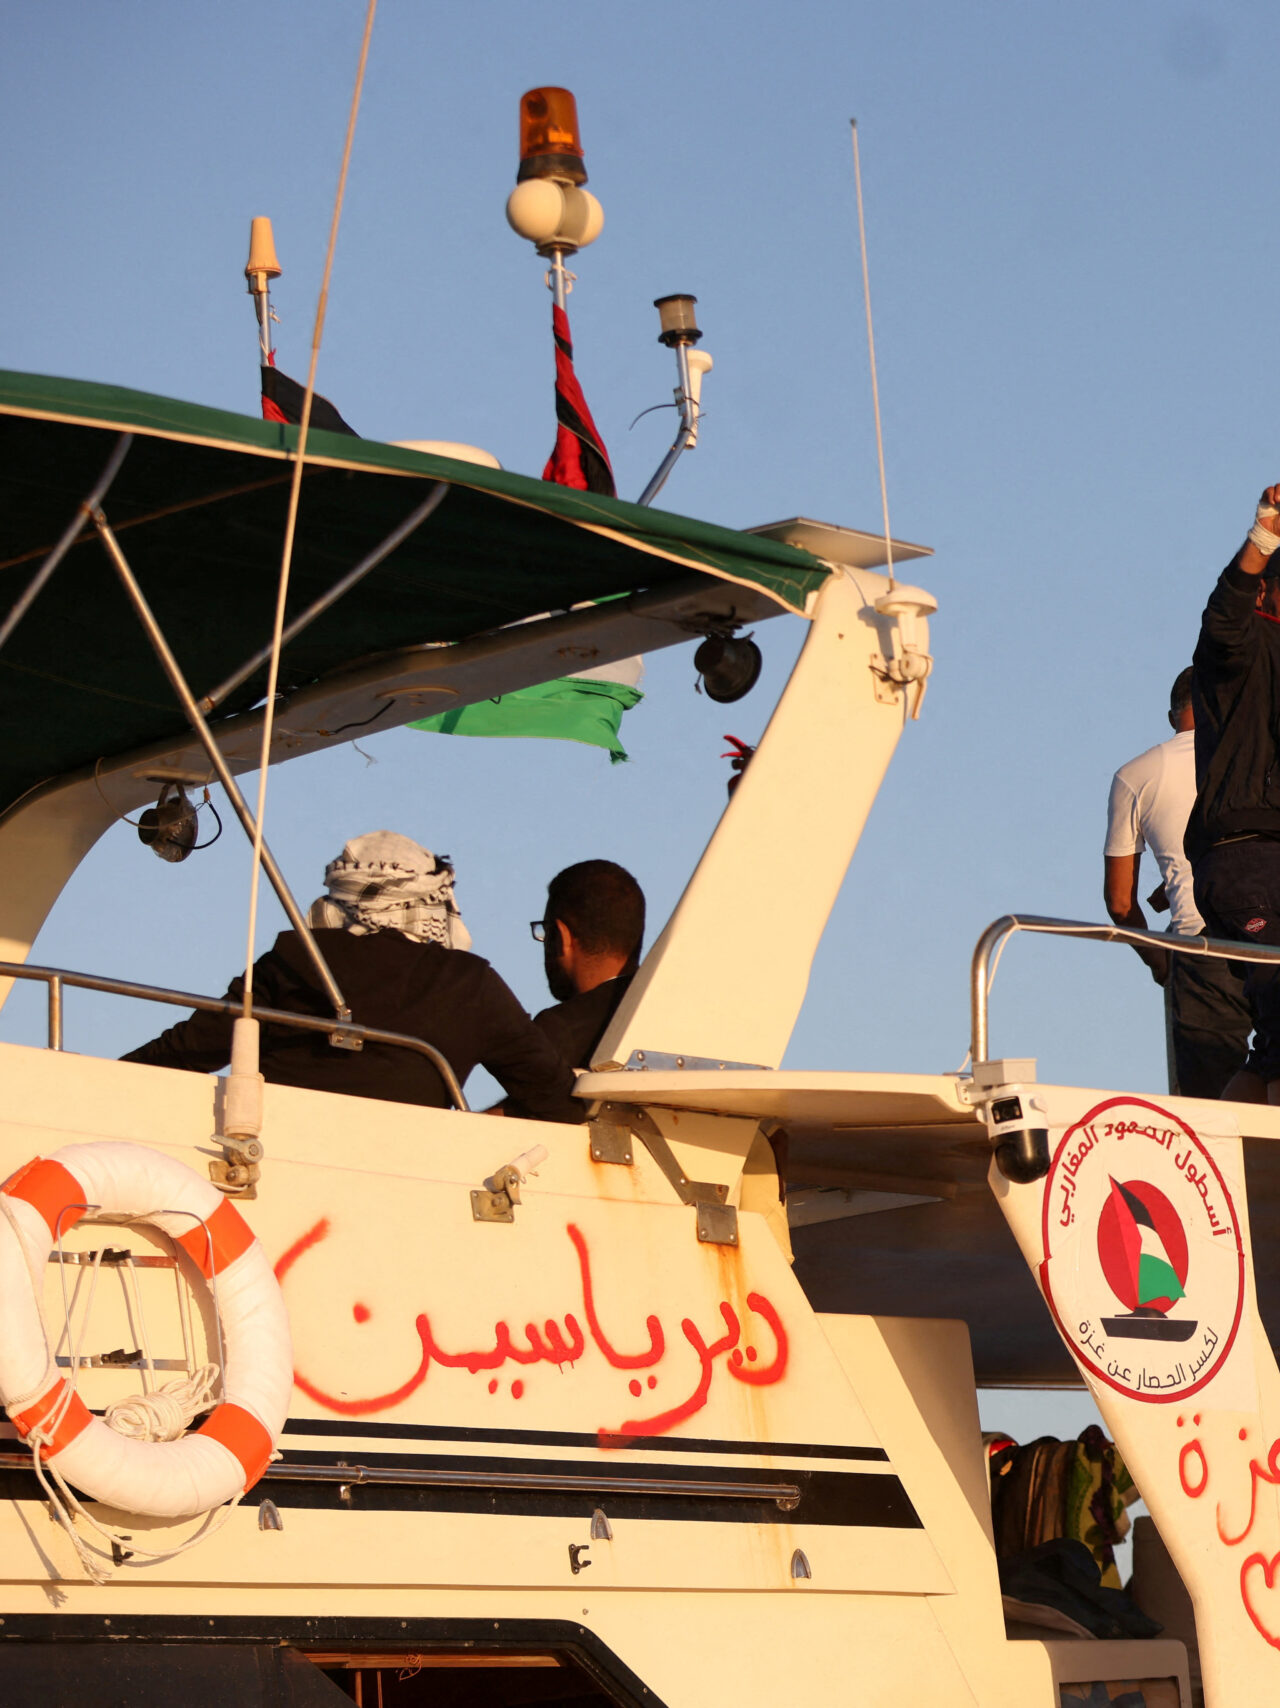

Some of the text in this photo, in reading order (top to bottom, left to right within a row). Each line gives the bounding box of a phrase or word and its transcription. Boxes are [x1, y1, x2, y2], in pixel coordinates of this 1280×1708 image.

[1060, 1125, 1099, 1227] المغاربي
[1175, 1150, 1232, 1236] أسطول
[1078, 1320, 1218, 1391] لكسر الحصار عن غزة
